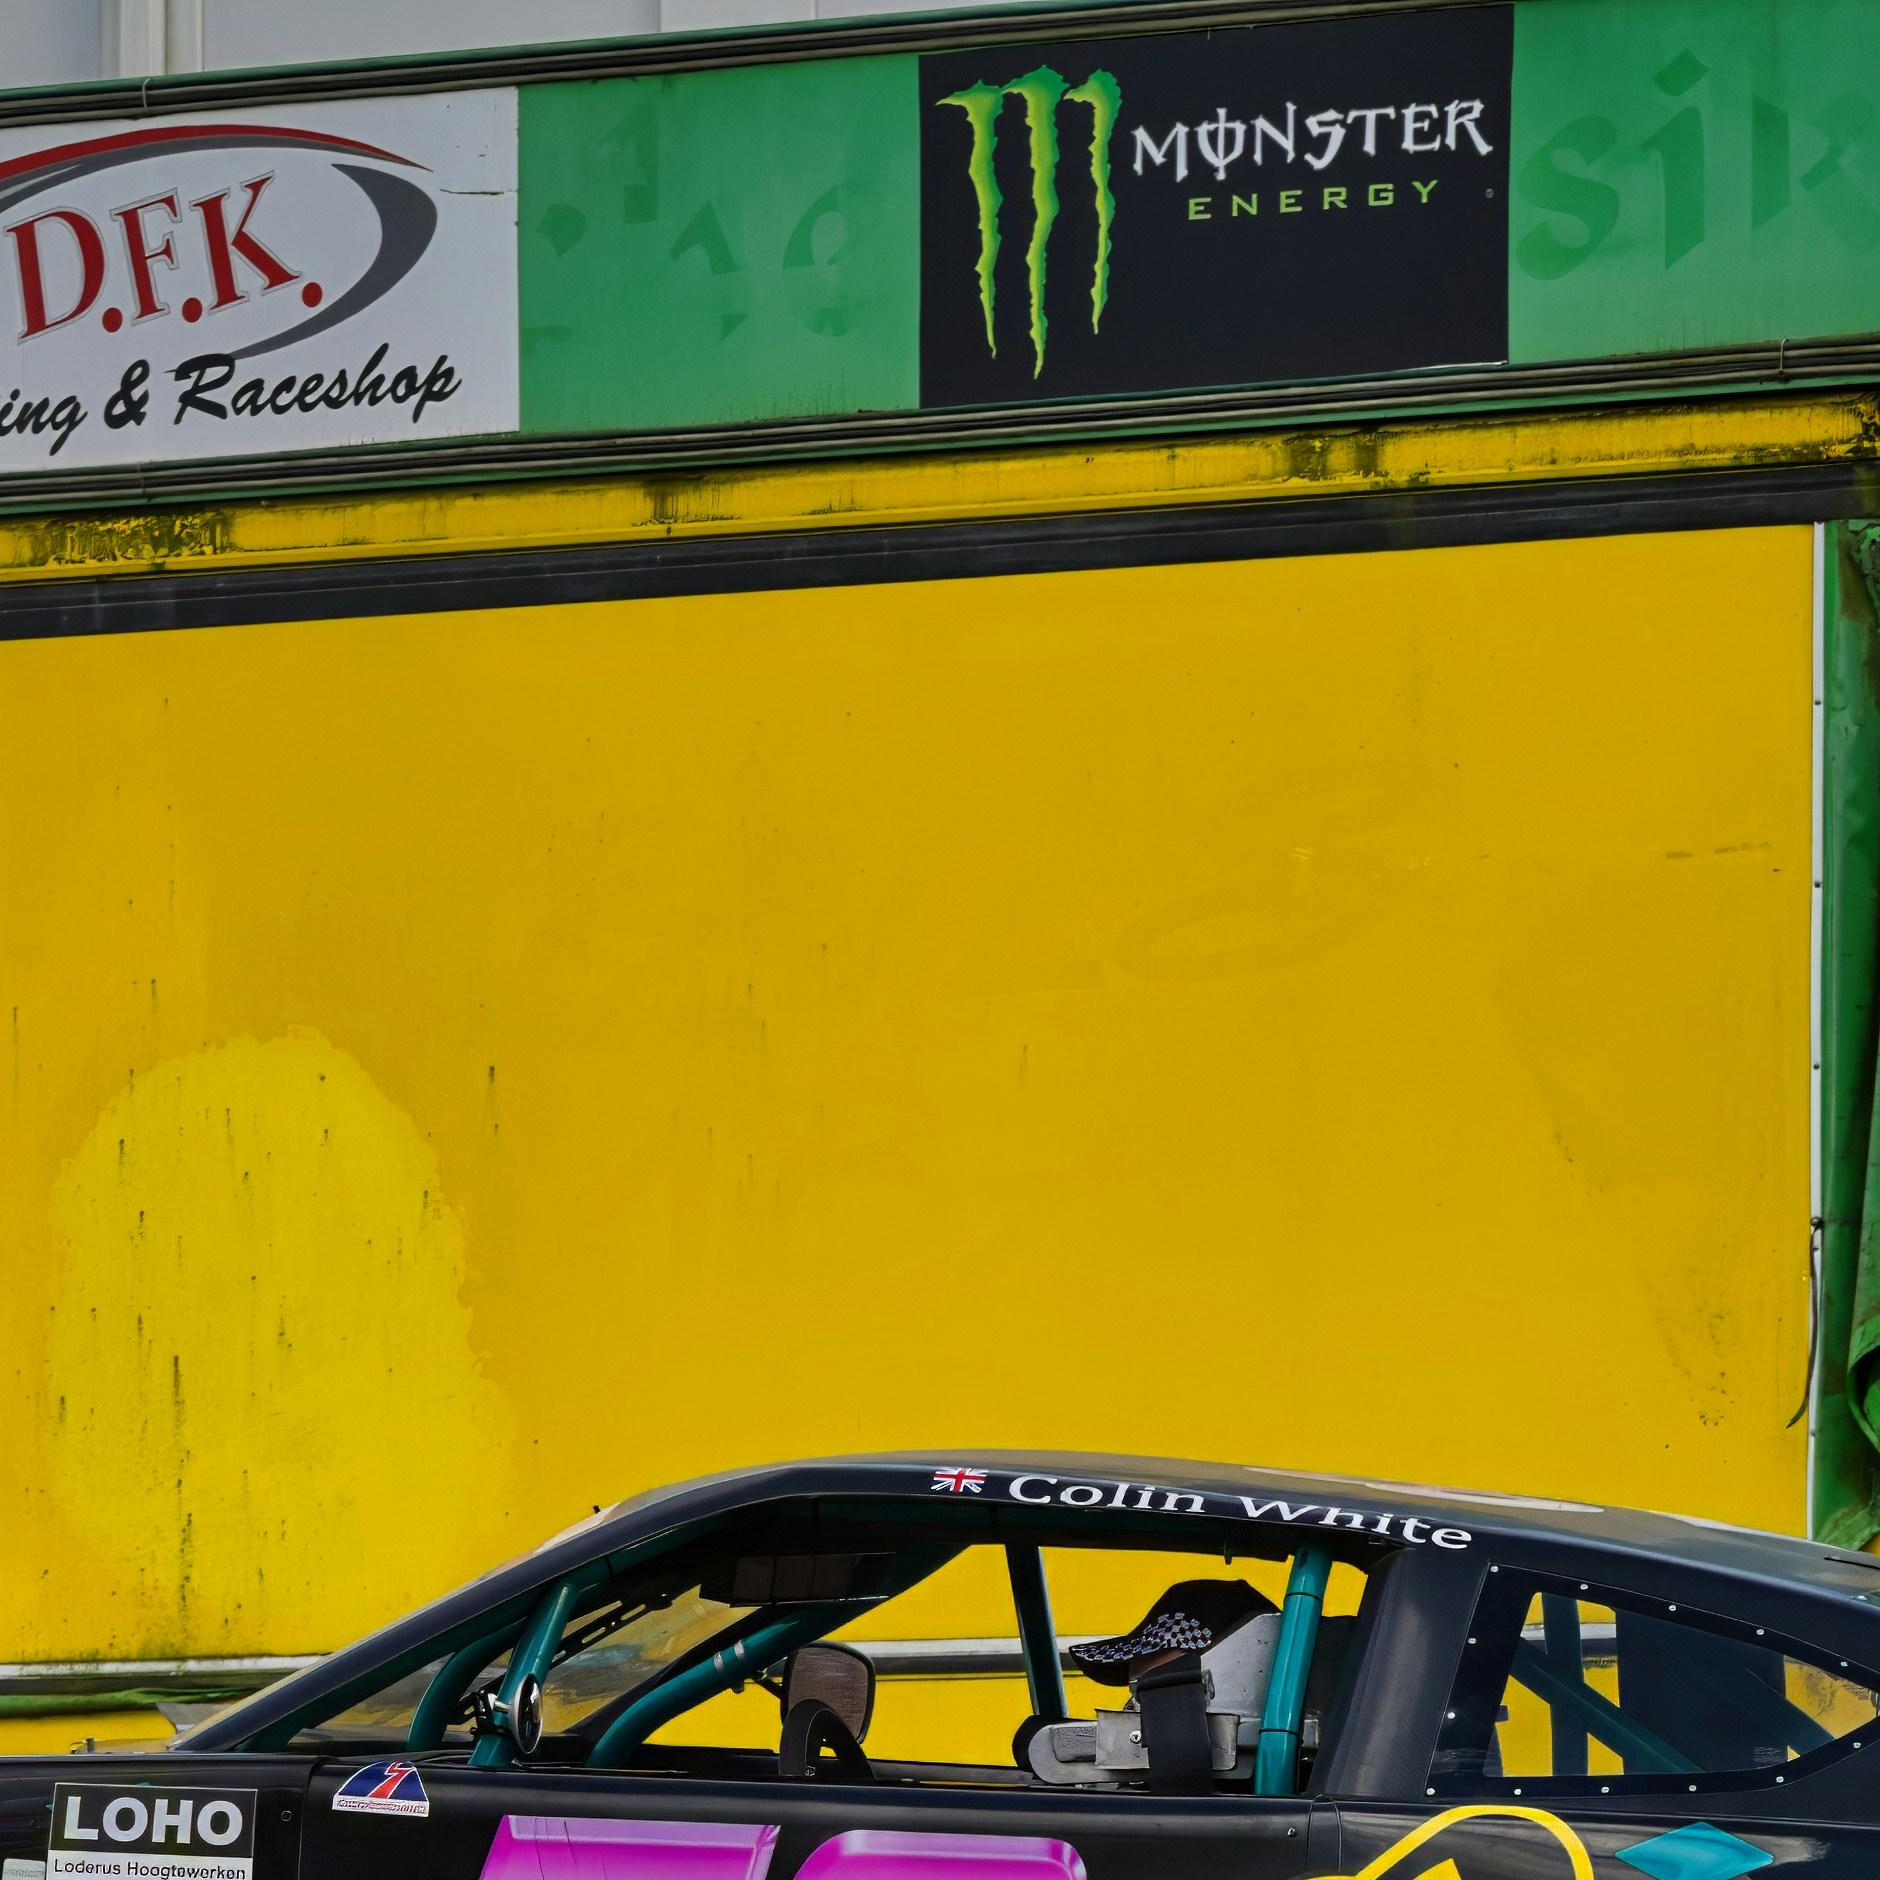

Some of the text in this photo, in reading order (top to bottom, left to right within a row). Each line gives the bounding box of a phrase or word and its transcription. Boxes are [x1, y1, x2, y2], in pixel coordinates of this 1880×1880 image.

[1131, 98, 1493, 182] MONSTER
[1187, 179, 1439, 221] ENERGY
[3, 169, 323, 345] D.F.K.
[103, 358, 150, 430] &
[171, 342, 462, 424] Raceshop
[1007, 1476, 1473, 1550] Colin White
[63, 1795, 244, 1847] LOHO
[54, 1858, 121, 1875] Loderus
